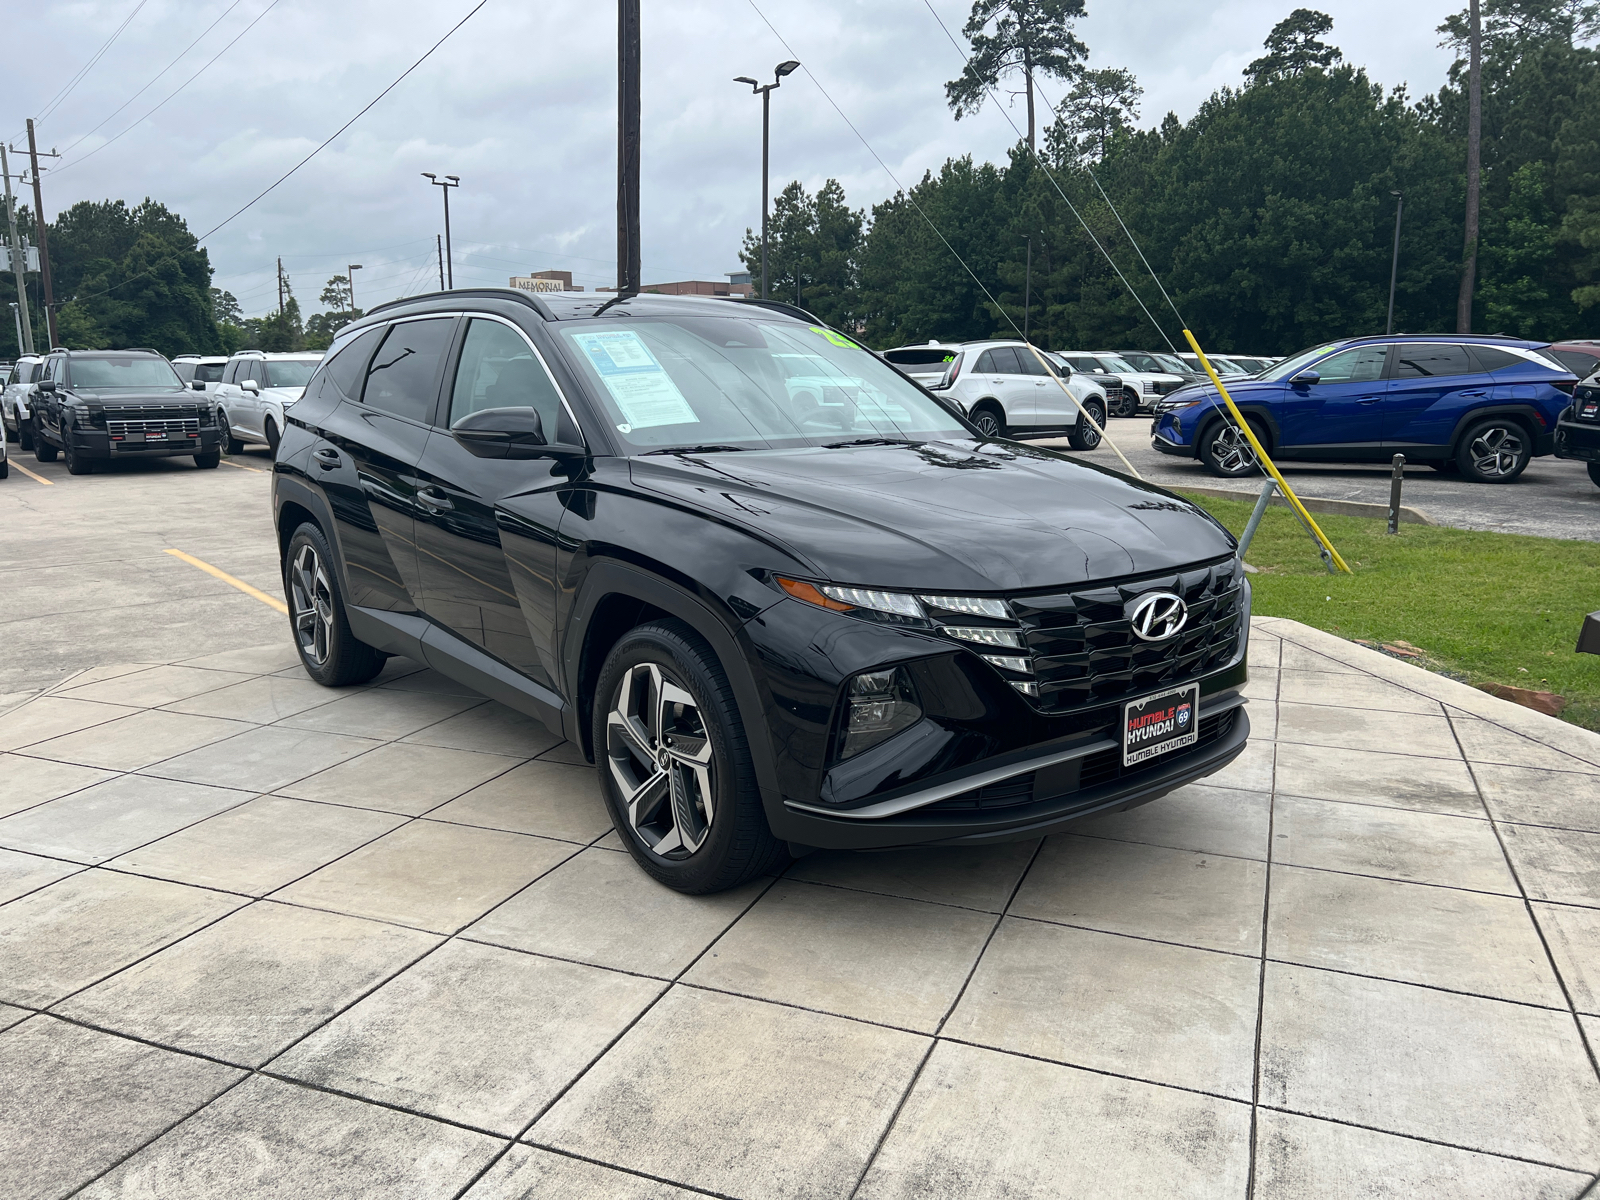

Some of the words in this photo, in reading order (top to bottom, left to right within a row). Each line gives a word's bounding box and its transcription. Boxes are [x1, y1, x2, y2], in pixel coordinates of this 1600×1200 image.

[518, 281, 562, 291] MEMORIAL
[1129, 707, 1175, 731] HUMBLE
[1178, 711, 1188, 723] 69
[1128, 718, 1174, 745] HYUNDAI
[1126, 746, 1159, 765] HUMBLE
[1160, 734, 1195, 752] HYUNDAI
